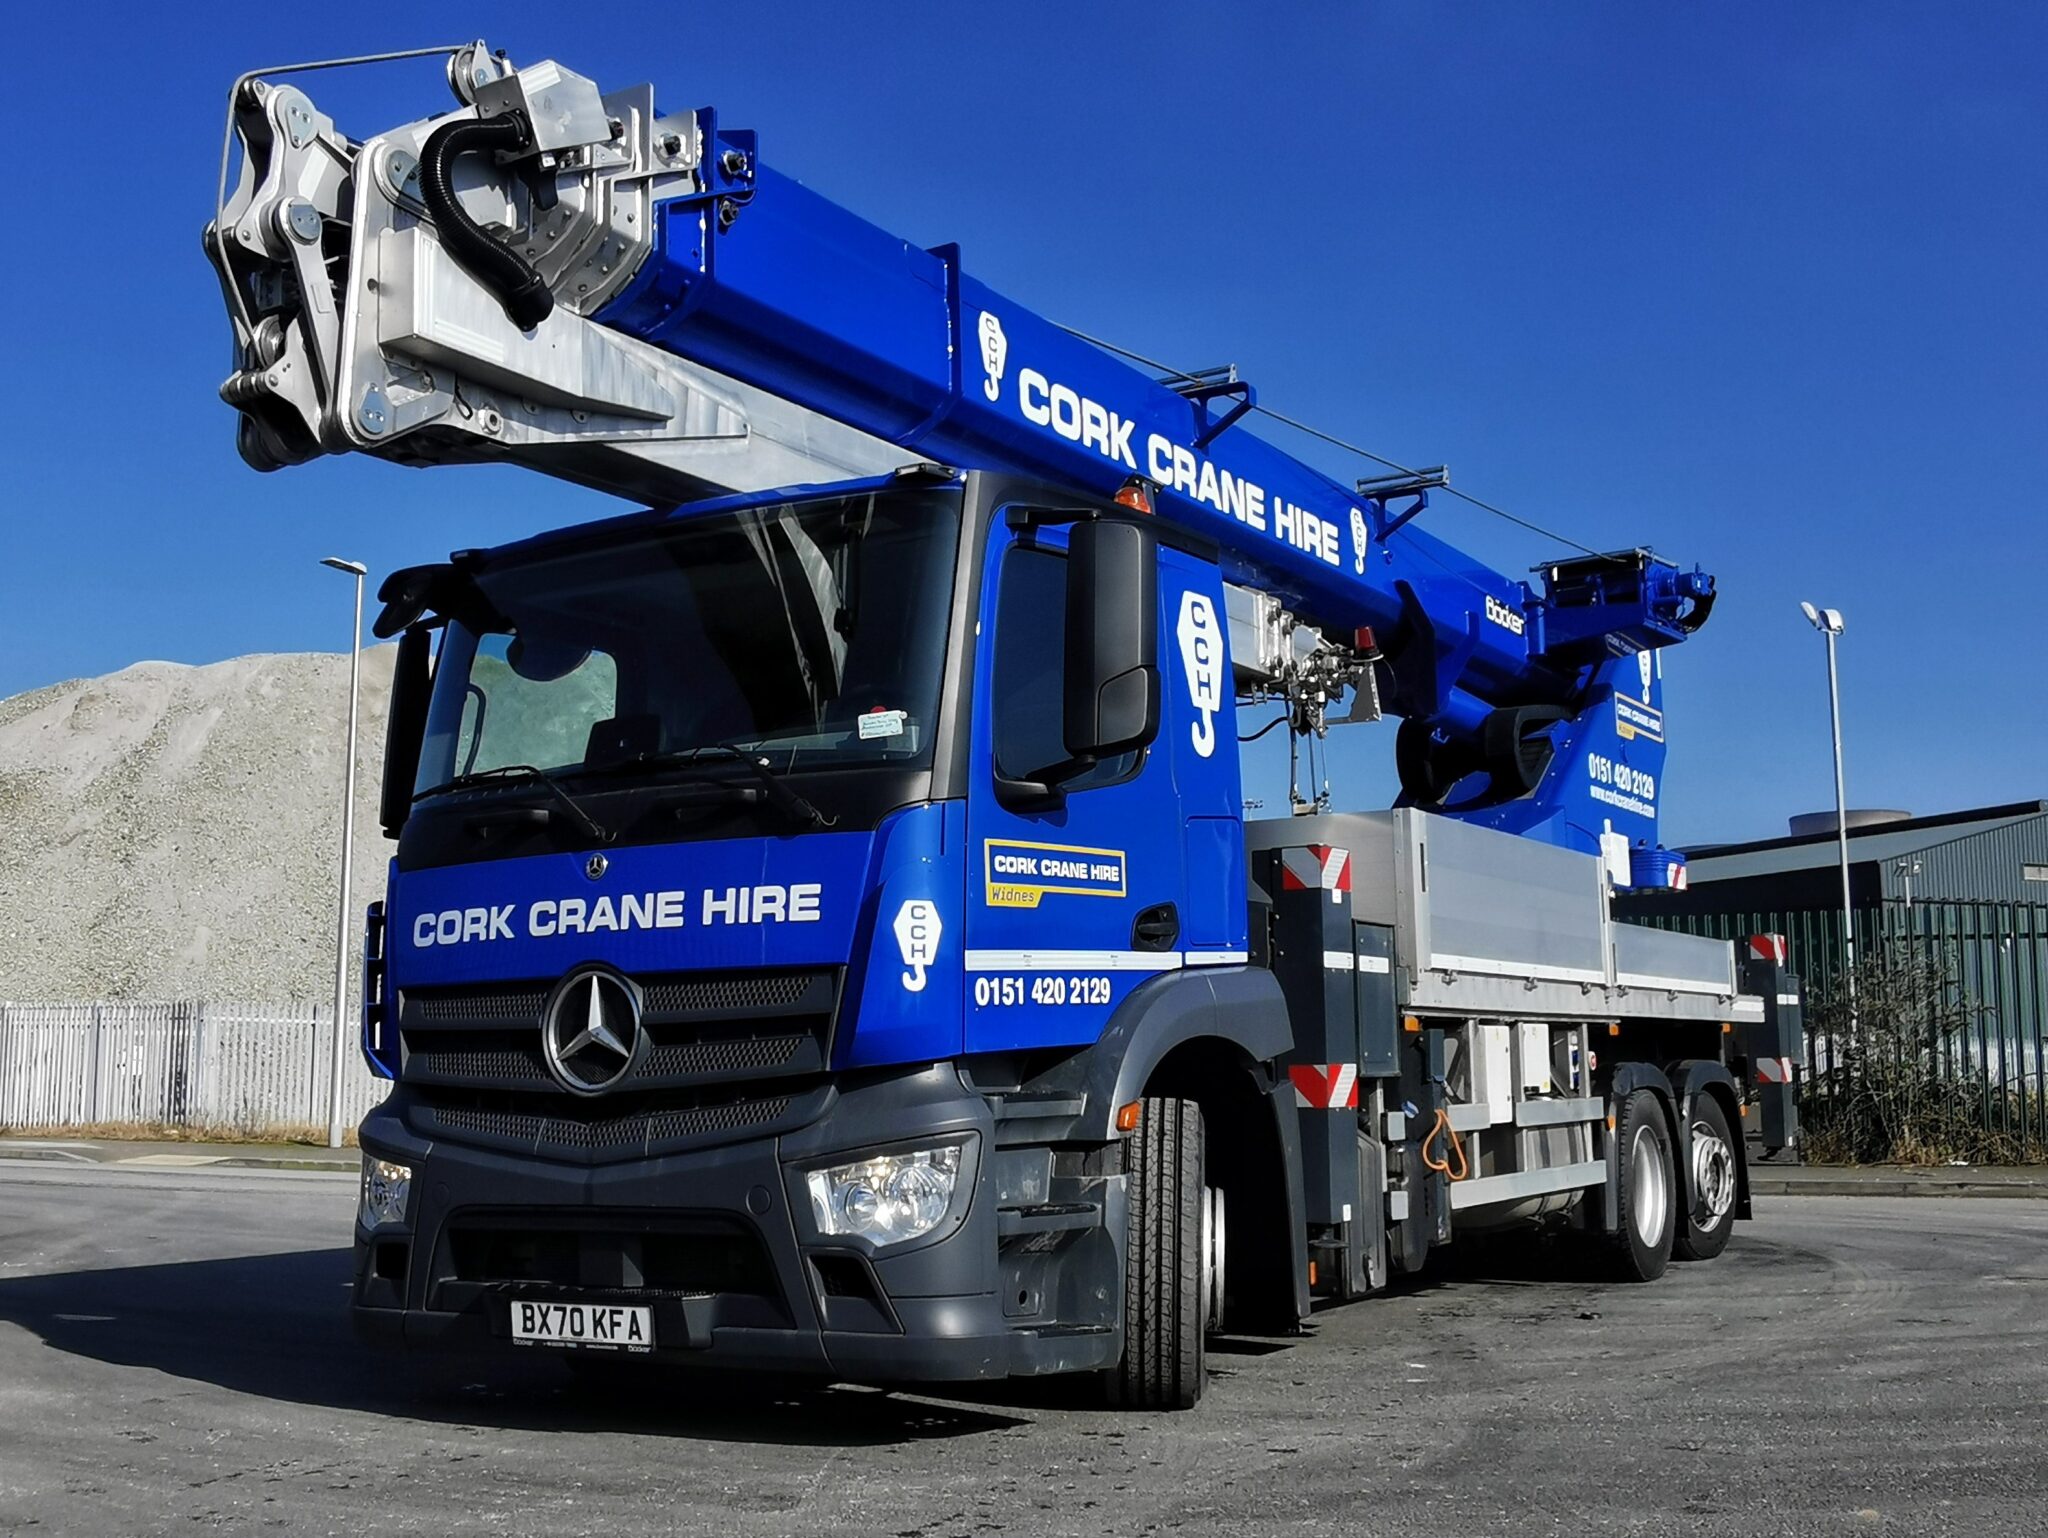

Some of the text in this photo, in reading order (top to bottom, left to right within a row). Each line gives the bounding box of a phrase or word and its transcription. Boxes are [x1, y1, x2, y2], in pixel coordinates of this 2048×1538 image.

[1018, 368, 1341, 567] CORK CRANE HIRE
[1588, 752, 1655, 800] 0151 420 2129
[994, 855, 1120, 882] CORK CRANE HIRE
[992, 887, 1035, 902] Widnes
[412, 883, 822, 948] CORK CRANE HIRE
[975, 976, 1111, 1006] 0151 420 2129
[521, 1303, 643, 1341] BX70 KFA
